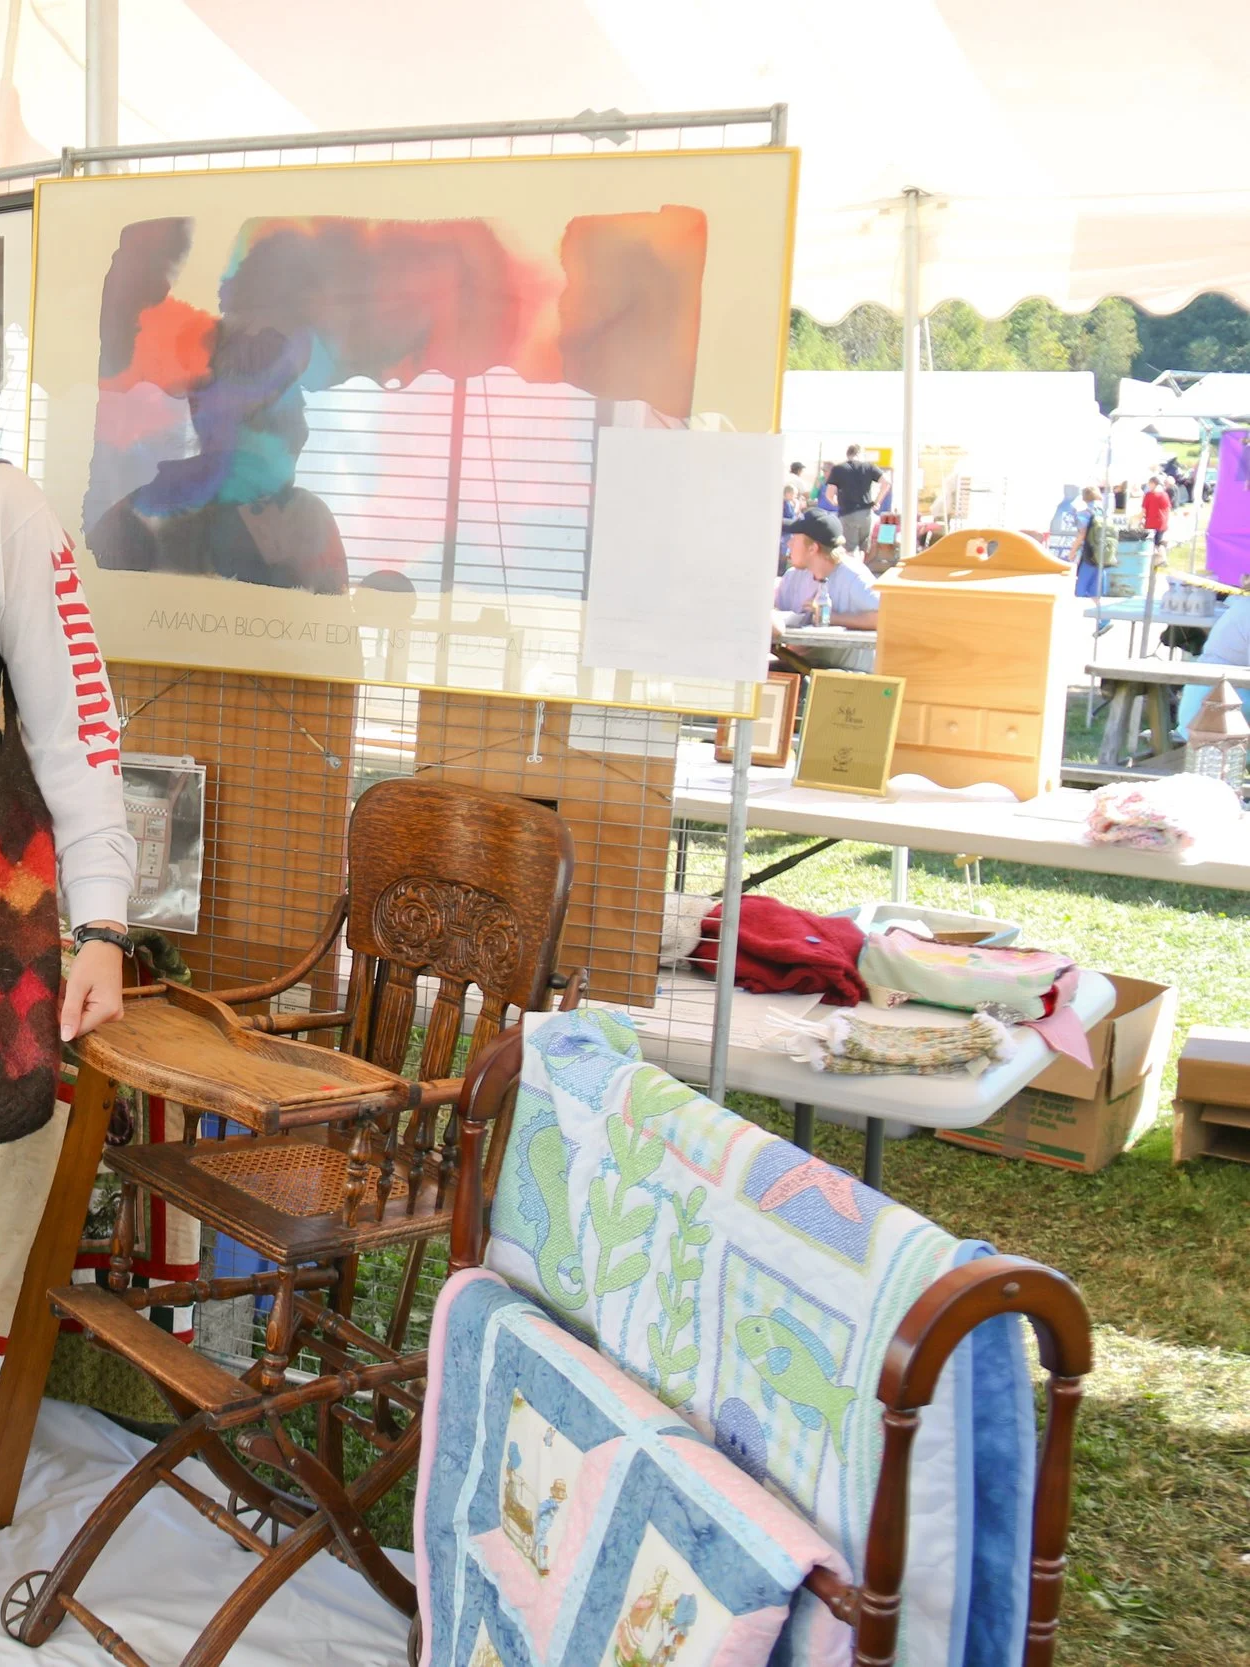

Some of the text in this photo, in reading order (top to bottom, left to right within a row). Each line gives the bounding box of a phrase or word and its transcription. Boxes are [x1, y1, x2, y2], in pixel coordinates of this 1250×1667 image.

[147, 609, 229, 634] AMANDA
[234, 616, 293, 641] BLOCK
[298, 622, 320, 641] AT
